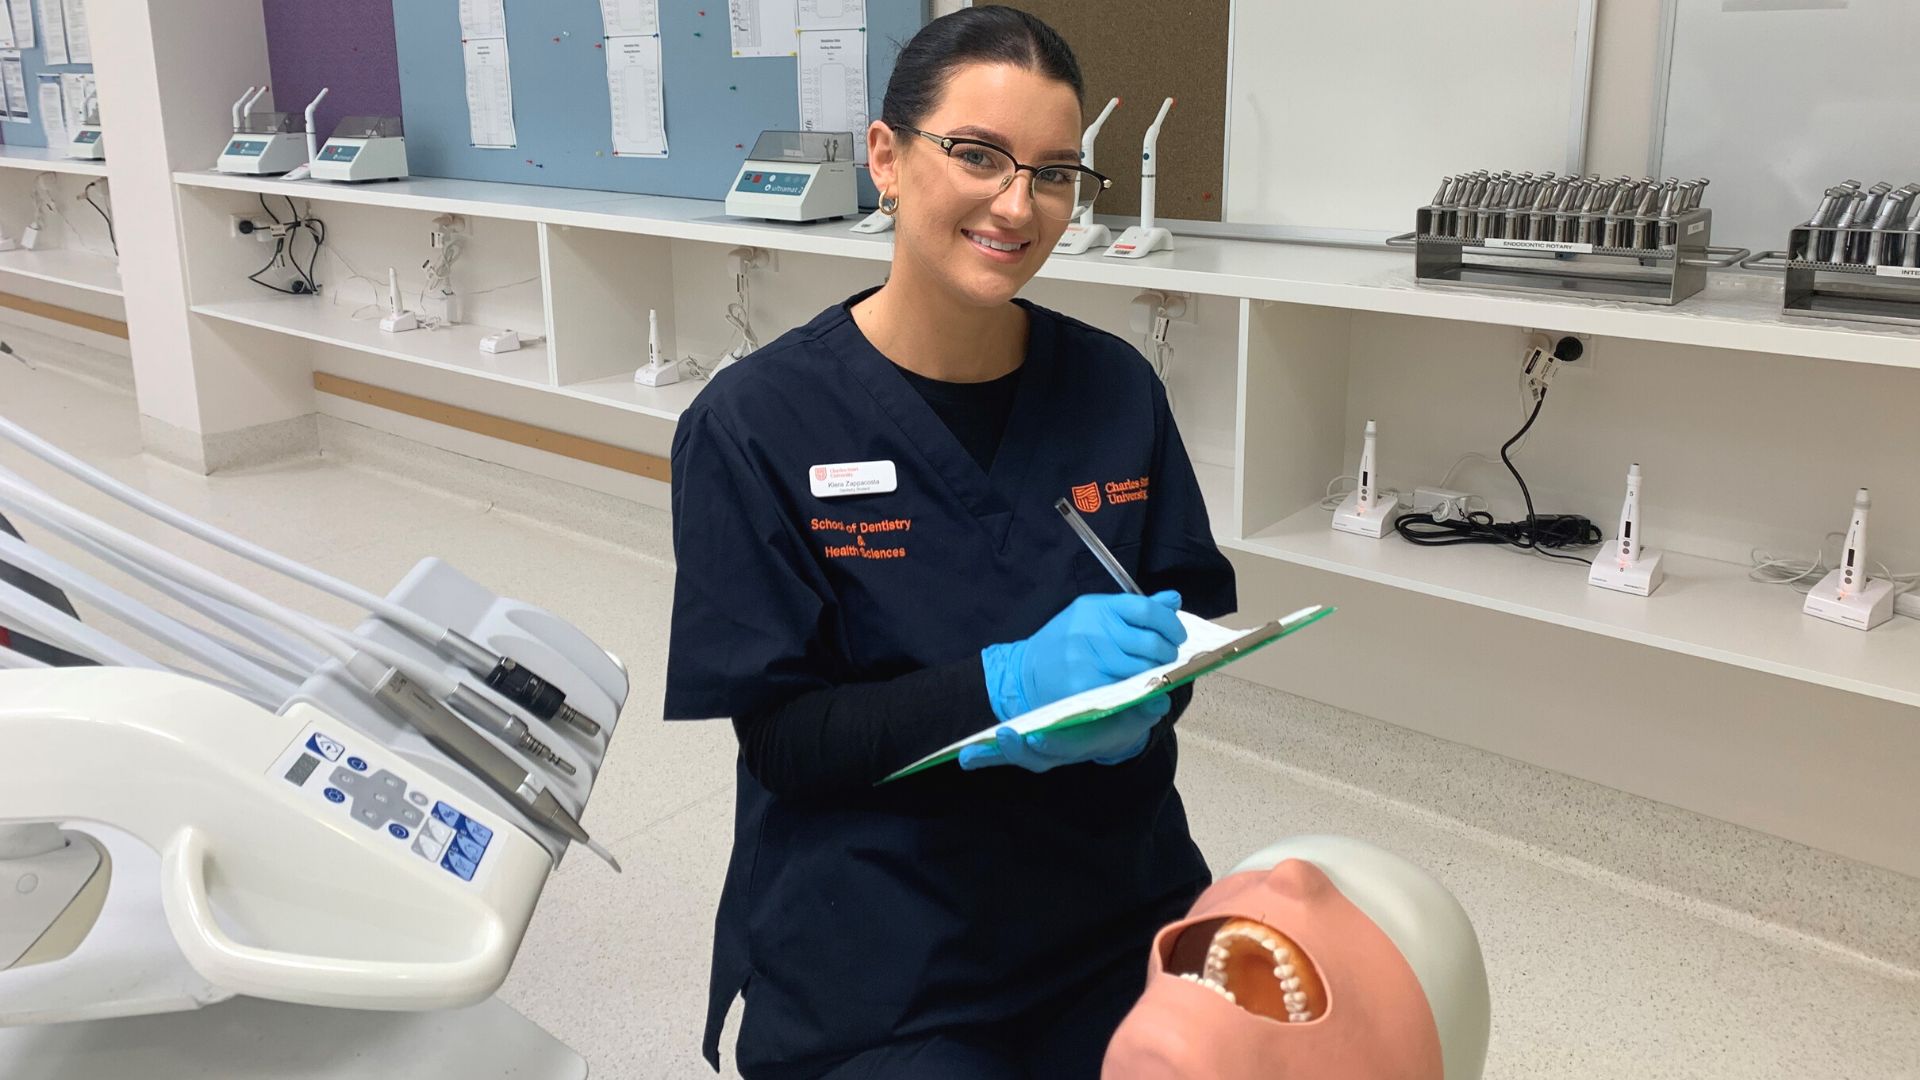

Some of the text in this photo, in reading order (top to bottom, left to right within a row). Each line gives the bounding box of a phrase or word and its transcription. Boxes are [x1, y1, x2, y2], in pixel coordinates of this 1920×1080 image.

[1503, 241, 1545, 249] ENDODONTIC
[1105, 478, 1139, 493] Charles
[845, 522, 857, 534] of
[860, 519, 911, 533] Dentistry
[857, 535, 866, 546] &
[825, 545, 906, 559] Health Sciences
